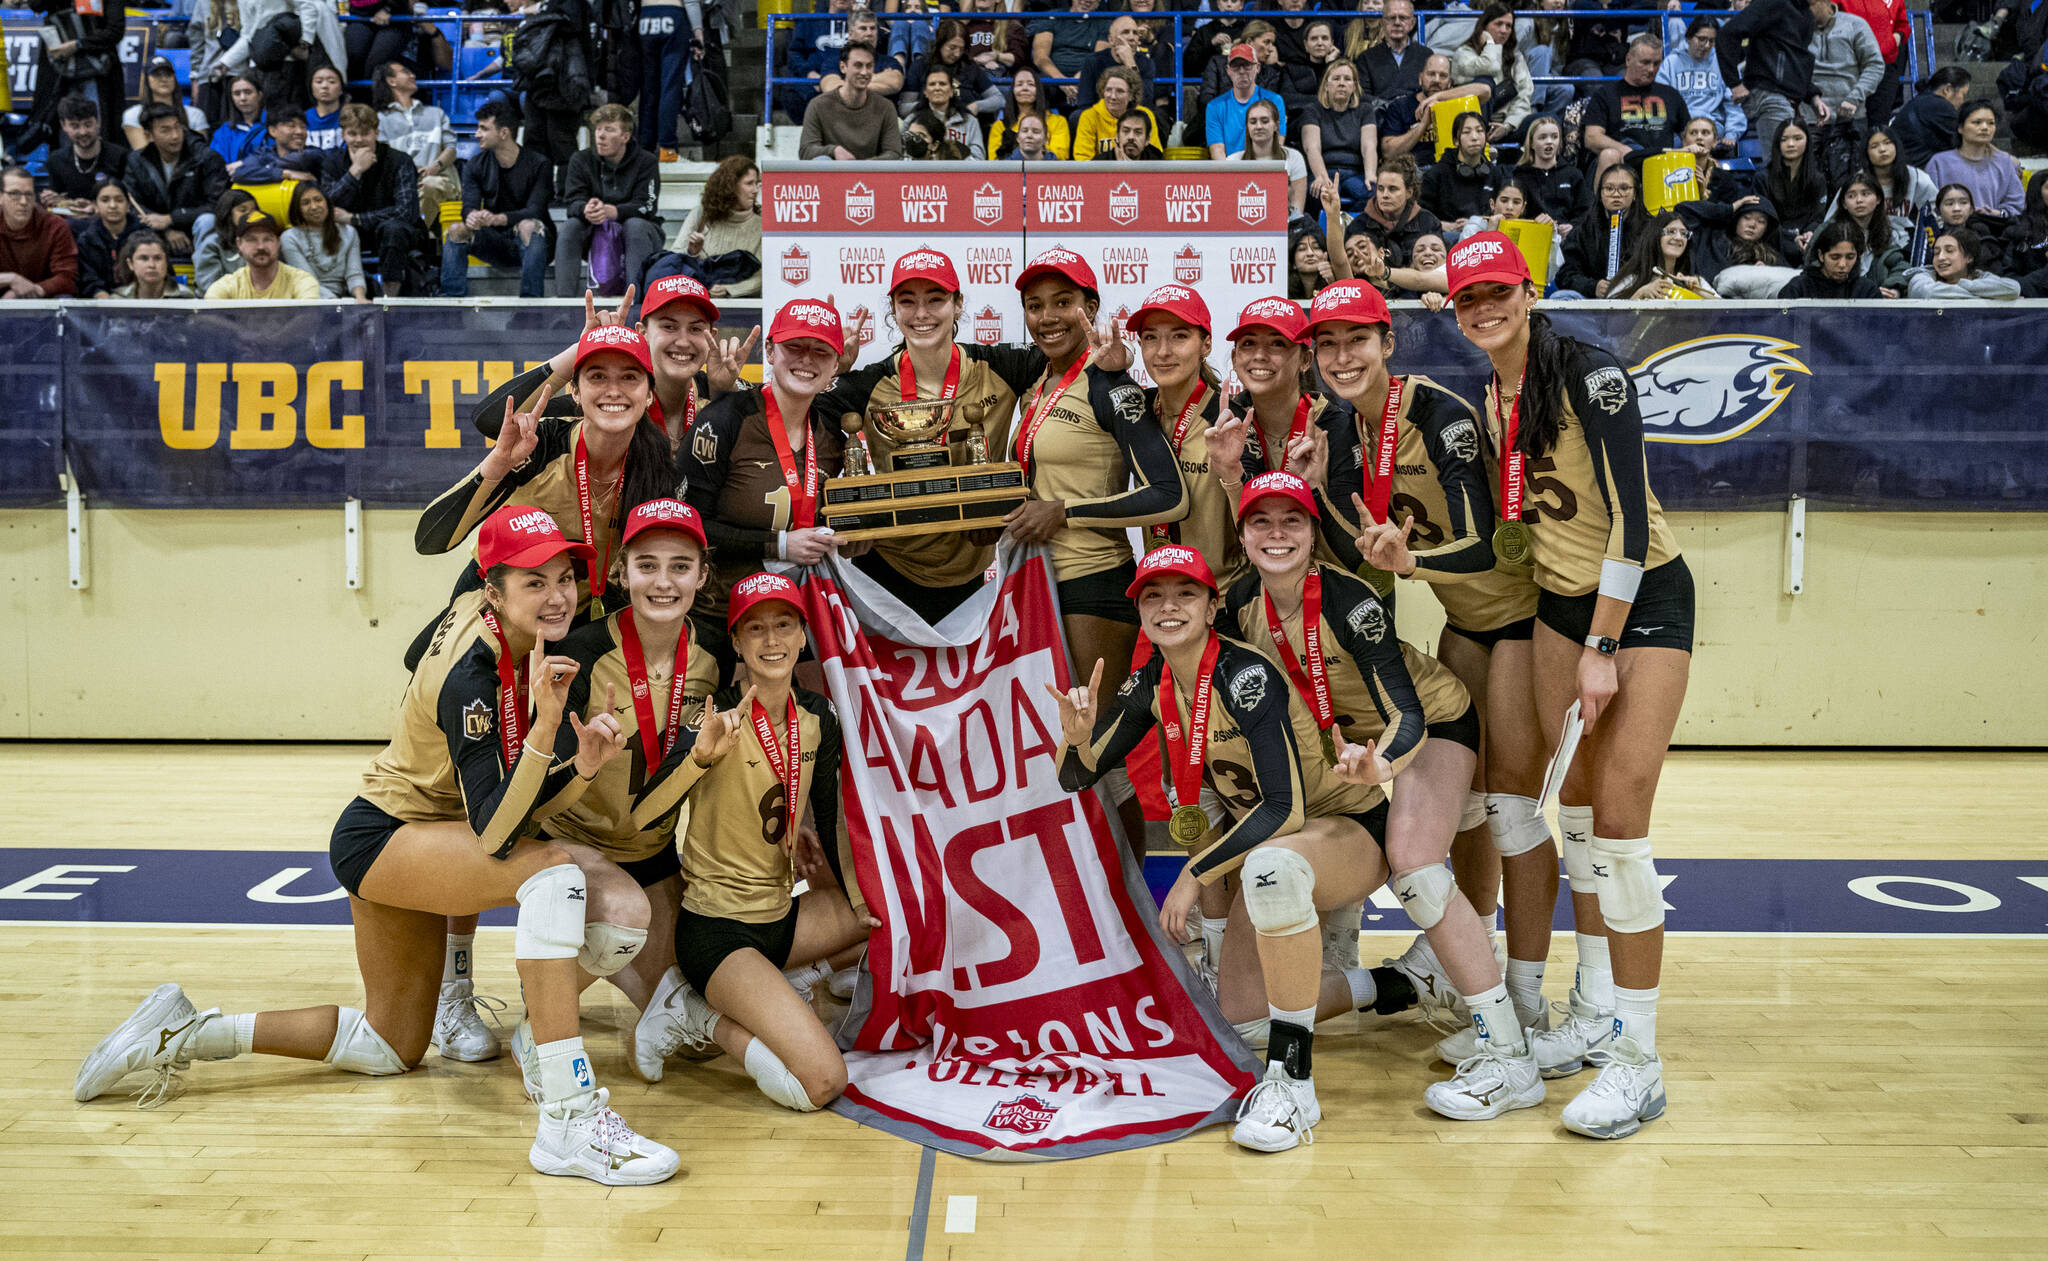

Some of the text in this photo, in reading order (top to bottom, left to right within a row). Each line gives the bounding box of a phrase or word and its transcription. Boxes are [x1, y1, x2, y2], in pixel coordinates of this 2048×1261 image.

[639, 16, 675, 35] UBC
[1676, 71, 1719, 91] UBC
[1620, 96, 1667, 124] 50
[773, 184, 820, 200] CANADA
[901, 185, 948, 200] CANADA
[1037, 184, 1084, 200] CANADA
[1165, 184, 1212, 200] CANADA
[774, 201, 820, 223] WEST
[848, 206, 872, 218] WEST
[901, 201, 948, 223] WEST
[975, 206, 1000, 218] WEST
[1038, 201, 1084, 223] WEST
[1111, 206, 1136, 218] WEST
[1165, 201, 1212, 223] WEST
[1240, 206, 1264, 218] WEST
[839, 247, 886, 262] CANADA
[899, 253, 945, 269] CHAMPIONS
[966, 247, 1013, 262] CANADA
[1102, 247, 1149, 262] CANADA
[1230, 247, 1276, 262] CANADA
[1450, 241, 1504, 267] CHAMPIONS
[783, 270, 808, 280] WEST
[840, 263, 886, 284] WEST
[967, 263, 1013, 284] WEST
[1103, 263, 1149, 284] WEST
[1175, 269, 1200, 280] WEST
[1230, 263, 1276, 284] WEST
[657, 278, 705, 296] CHAMPIONS
[1313, 286, 1361, 308] CHAMPIONS
[789, 304, 837, 326] CHAMPIONS
[1246, 299, 1294, 316] CHAMPIONS
[587, 325, 640, 343] CHAMPIONS
[975, 330, 1000, 341] WEST
[153, 360, 366, 450] UBC
[1023, 387, 1066, 462] WOMEN'S VOLLEYBALL
[1174, 403, 1199, 438] WOMEN'S
[1379, 384, 1401, 477] WOMEN'S VOLLEYBALL
[694, 436, 715, 459] CW
[806, 461, 817, 498] WOMEN'S
[1251, 472, 1304, 490] CHAMPIONS
[1523, 456, 1578, 525] 5
[577, 459, 594, 546] OMEN'S VOLLEYBALL
[637, 500, 692, 518] CHAMPIONS
[1143, 547, 1194, 568] CHAMPIONS
[738, 574, 790, 595] CHAMPIONS
[1300, 654, 1342, 667] BNS
[1307, 625, 1331, 720] WOMEN'S VOLLEYBALL
[503, 685, 519, 735] VOLLEYBALL
[664, 673, 685, 755] MEN'S VOLLEYBALL
[1189, 673, 1212, 766] WOMEN'S VOLLEYBALL
[464, 713, 490, 735] CW
[758, 715, 785, 767] VOLLEYBALL
[789, 719, 799, 814] WOMEN'S VOLLEYBALL
[758, 782, 788, 845] 6
[995, 1113, 1051, 1132] WEST
[998, 1104, 1054, 1121] CANADA
